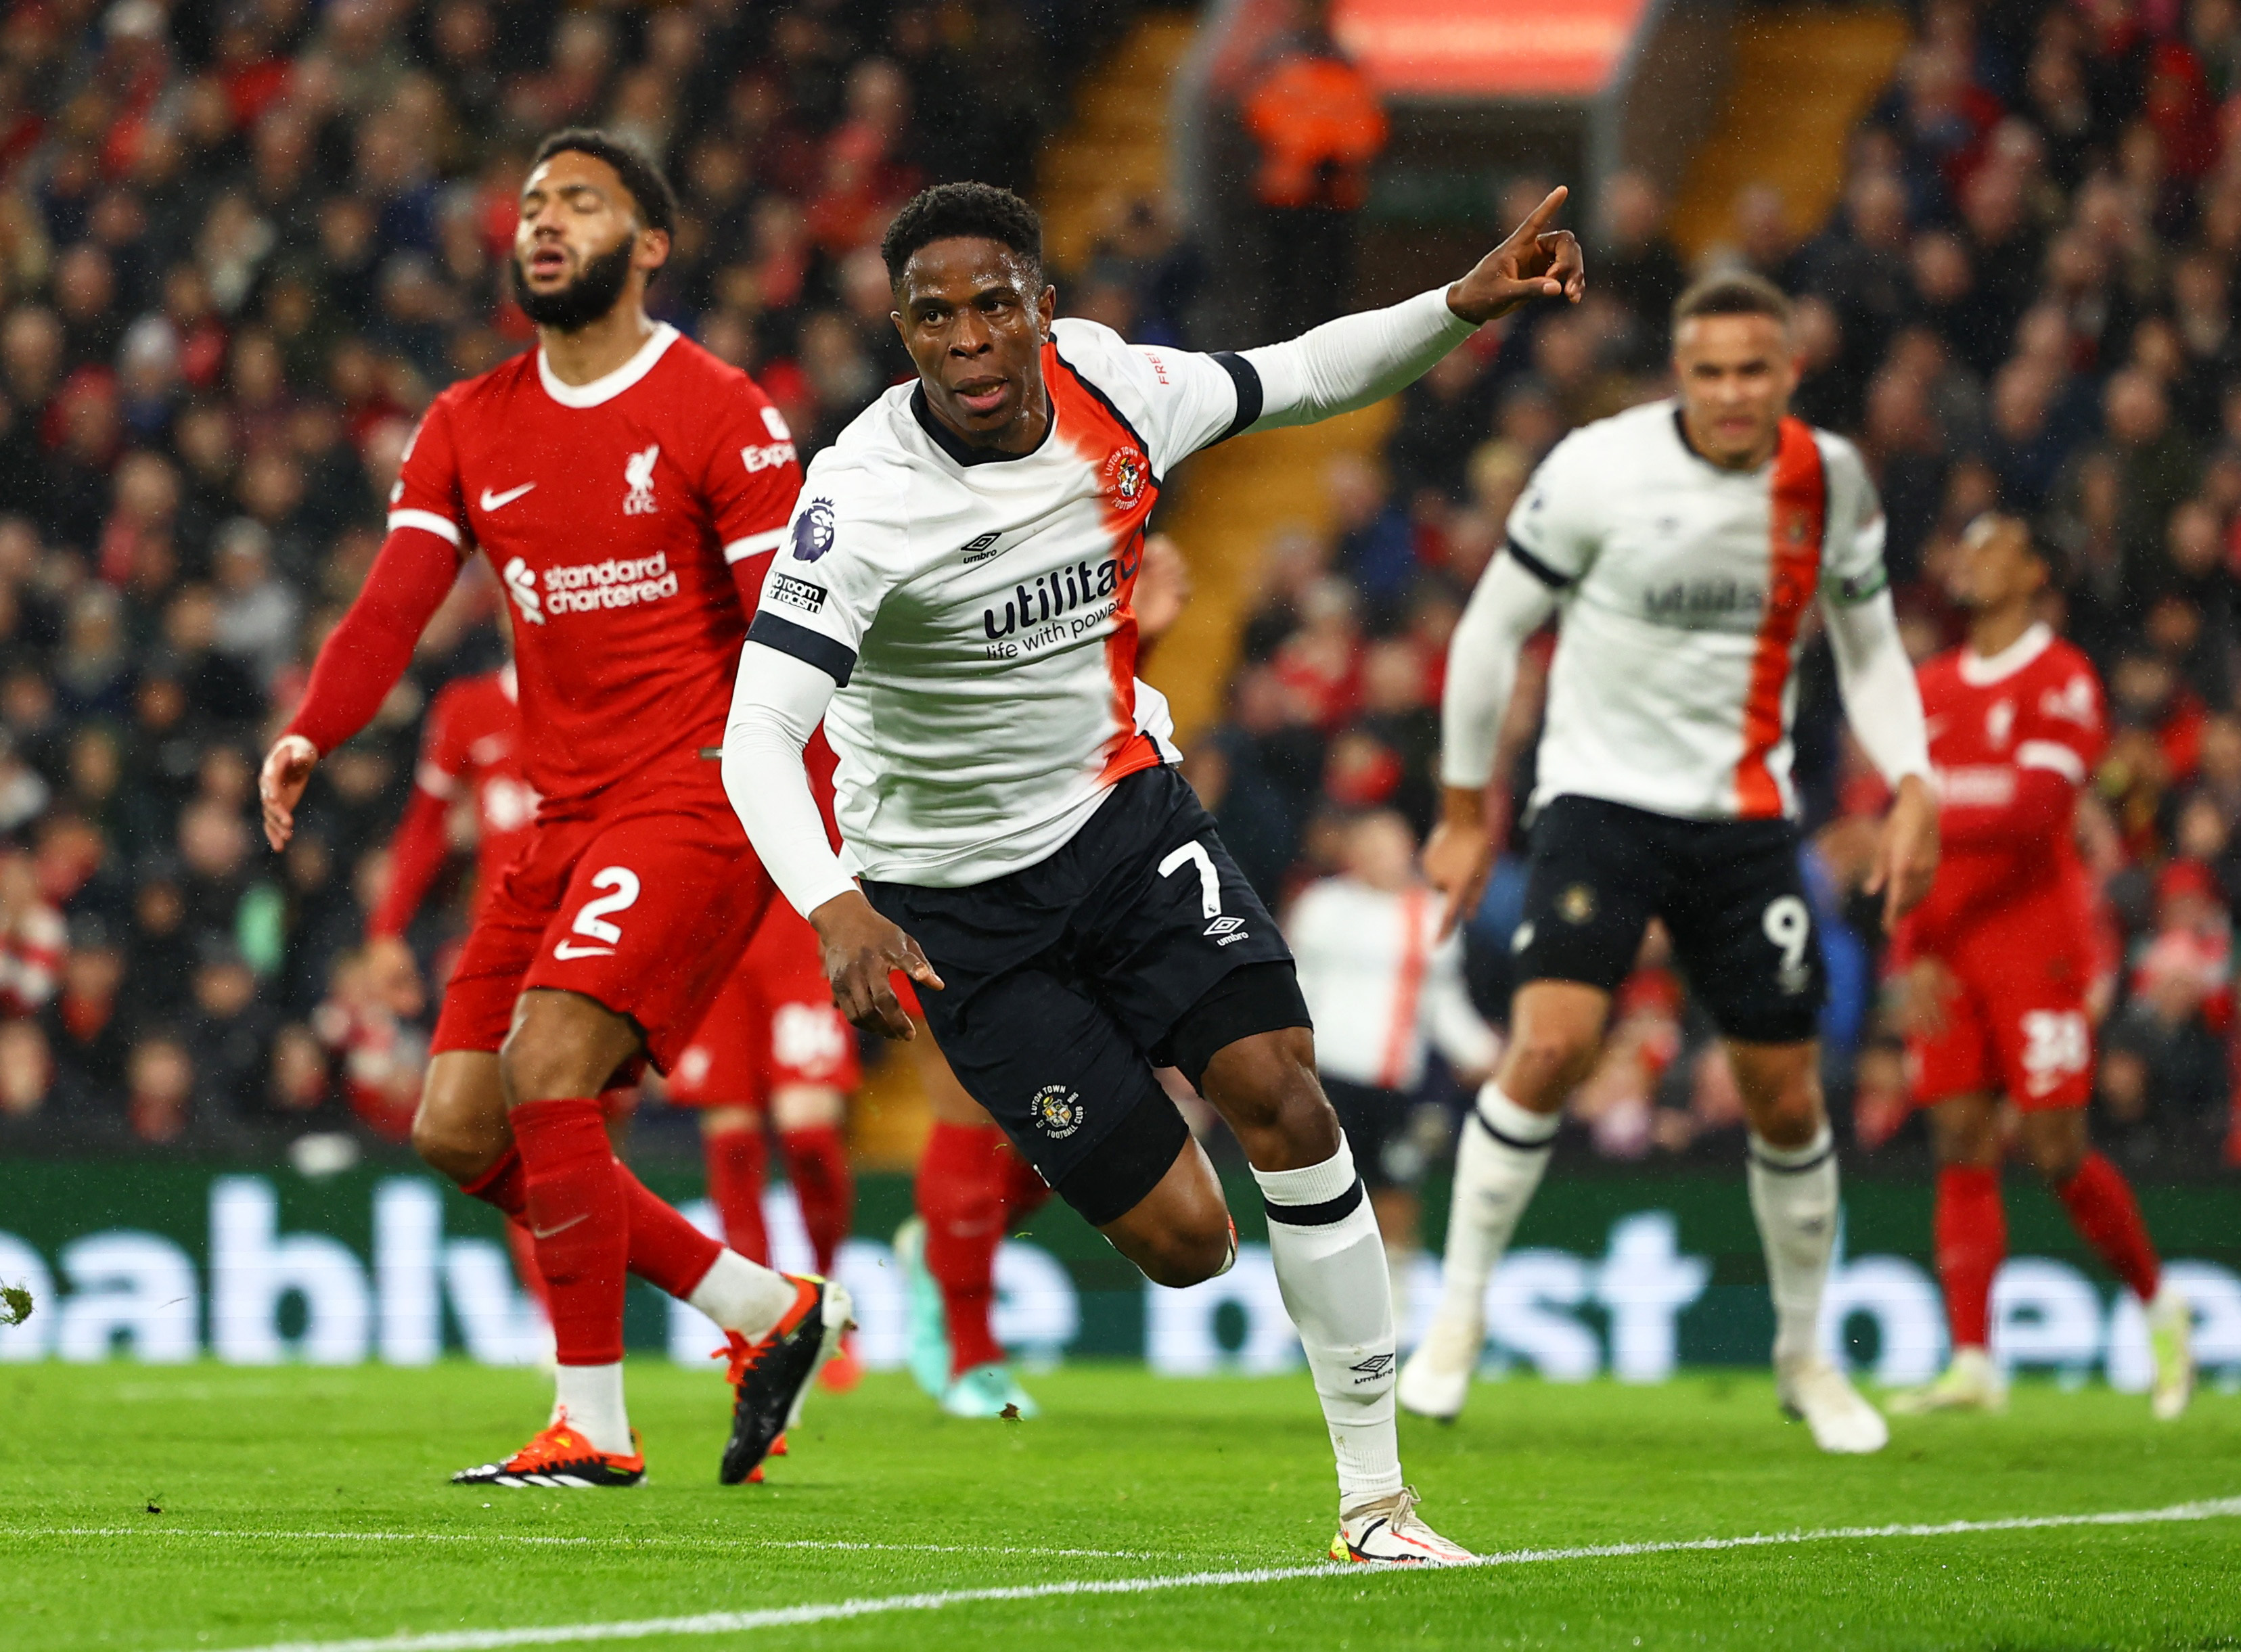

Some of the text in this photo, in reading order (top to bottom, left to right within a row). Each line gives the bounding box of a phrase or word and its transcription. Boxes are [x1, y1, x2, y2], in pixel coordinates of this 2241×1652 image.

[1105, 450, 1121, 476] LUTON
[1120, 446, 1138, 457] TOWN
[543, 549, 667, 592] standard
[963, 549, 997, 564] umbro
[545, 570, 679, 615] chartered
[777, 589, 821, 614] racism
[782, 578, 819, 600] room
[984, 560, 1118, 639] utilita
[986, 598, 1121, 659] life with power
[1158, 840, 1221, 919] 7
[572, 866, 641, 945] 2
[1217, 932, 1249, 946] umbro
[1762, 895, 1810, 971] 9
[1031, 1084, 1066, 1116] LUTON TOWN
[1047, 1105, 1084, 1139] FOOTBALL CLUB
[1355, 1368, 1393, 1384] umbro
